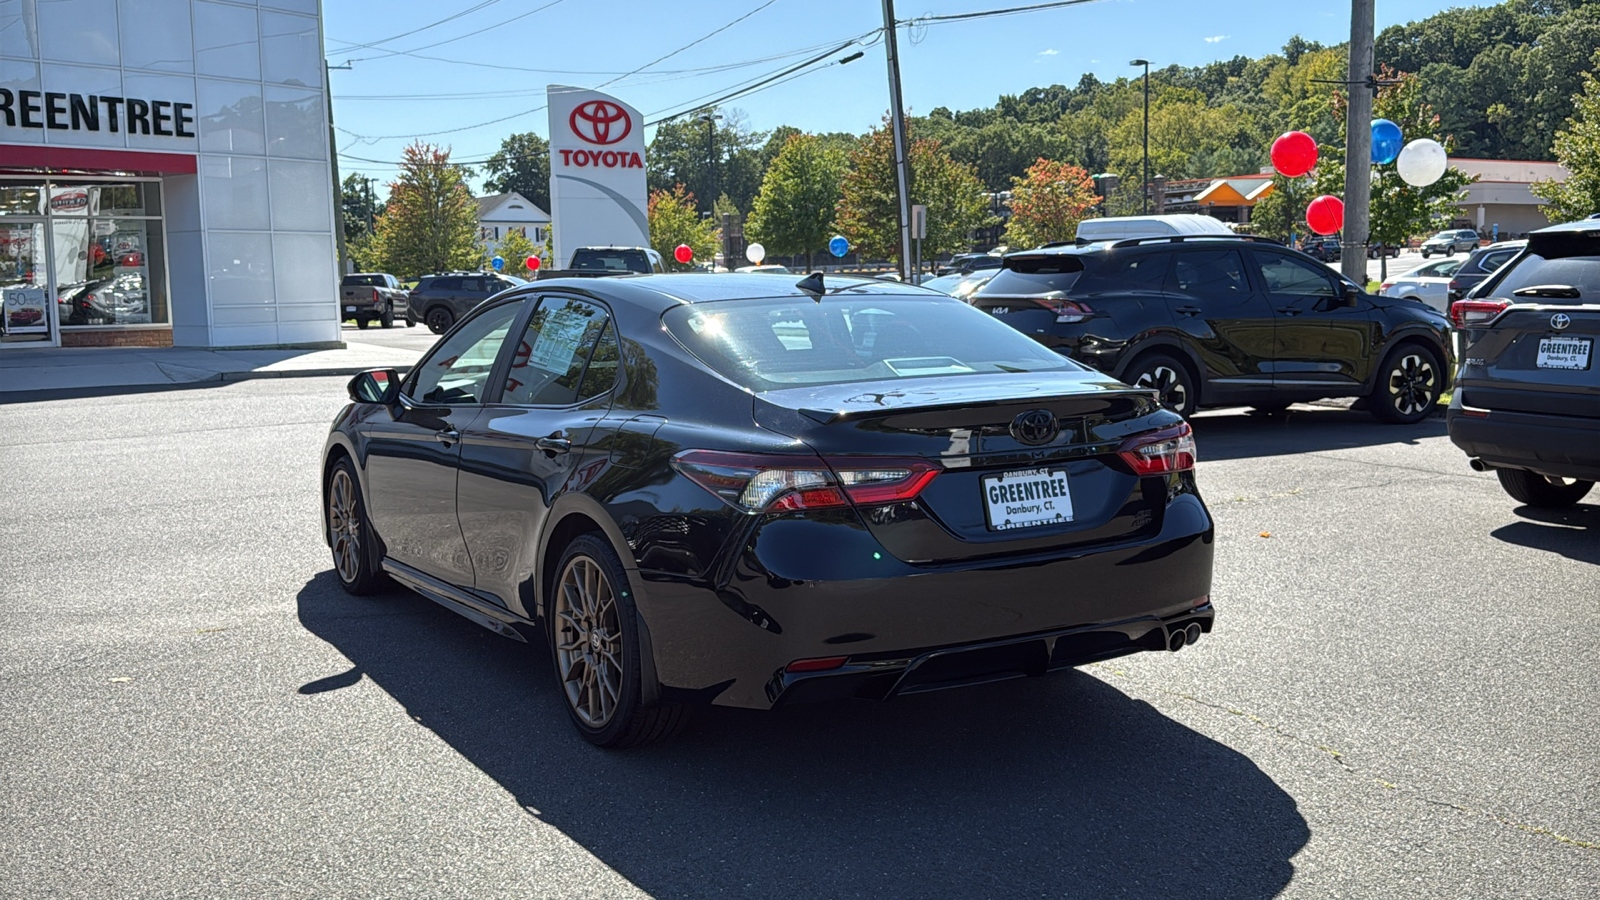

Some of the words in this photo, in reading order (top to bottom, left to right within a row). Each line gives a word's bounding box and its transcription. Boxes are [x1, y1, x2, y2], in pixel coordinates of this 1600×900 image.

[0, 88, 195, 138] REENTREE
[559, 149, 643, 168] TOYOTA
[8, 292, 26, 306] 50
[1540, 343, 1588, 355] GREENTREE
[1039, 467, 1049, 475] CT
[989, 478, 1067, 505] GREENTREE
[1006, 504, 1042, 515] Danbury,
[1043, 501, 1056, 510] CT.
[996, 516, 1074, 531] GREENTREE
